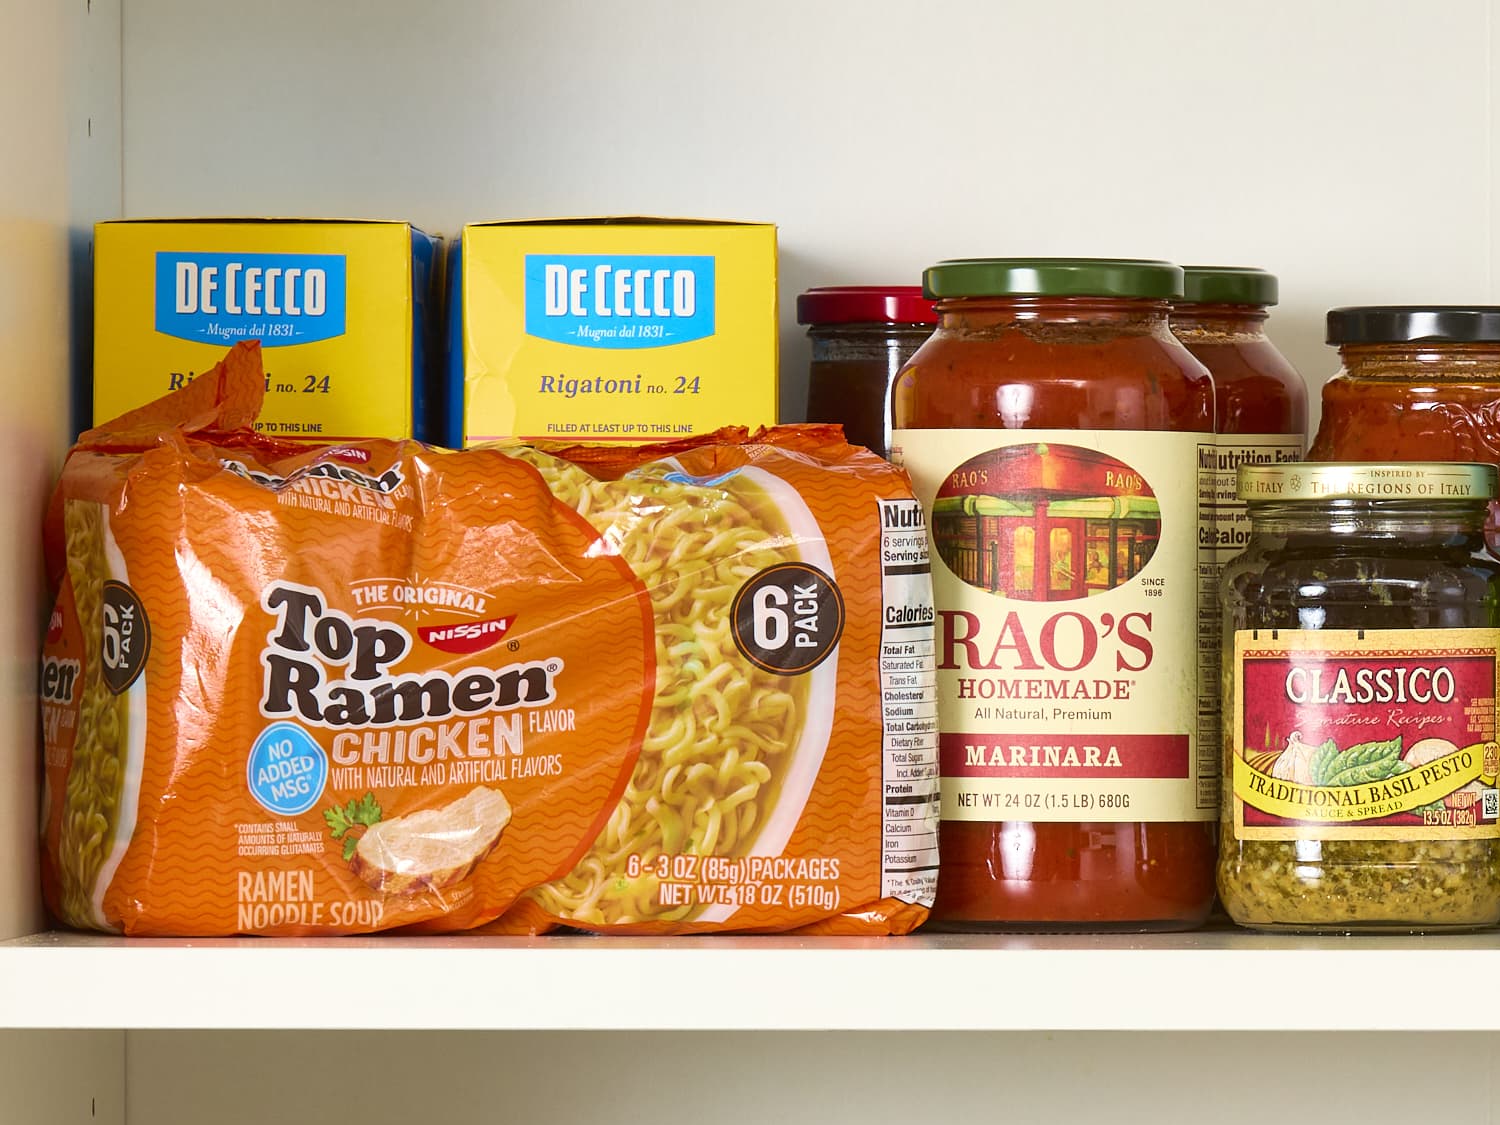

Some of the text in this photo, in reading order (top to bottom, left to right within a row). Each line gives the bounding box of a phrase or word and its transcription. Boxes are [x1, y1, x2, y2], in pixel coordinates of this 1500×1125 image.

[577, 325, 664, 341] Mugnai dal 1831
[539, 374, 701, 398] Rigatoni no. 24
[547, 424, 577, 432] FILLED
[580, 424, 590, 432] AT
[593, 424, 619, 432] LEAST
[651, 425, 670, 433] THIS
[673, 425, 693, 433] LINE
[1141, 578, 1165, 586] SINCE
[1144, 589, 1162, 597] 1896
[352, 584, 486, 613] THE ORIGINAL
[753, 583, 818, 650] 6 PACK
[886, 605, 934, 623] Calories
[268, 587, 406, 681] Top
[428, 618, 506, 644] NISSIN
[938, 610, 1154, 673] RAO'S
[264, 654, 553, 726] Ramen
[958, 679, 1130, 700] HOMEMADE
[1285, 666, 1455, 704] CLASSICO
[975, 707, 1112, 721] All Natural, Premium
[332, 709, 575, 765] CHICKEN FLAVOR
[268, 739, 293, 762] NO
[965, 745, 1122, 768] MARINARA
[258, 756, 314, 786] ADDED
[1248, 752, 1473, 807] TRADITIONAL BASIL PESTO
[958, 793, 1130, 809] NET WT 24 OZ (1.5 LB) 680G
[238, 870, 314, 902] RAMEN
[237, 900, 384, 930] NOODLE SOUP
